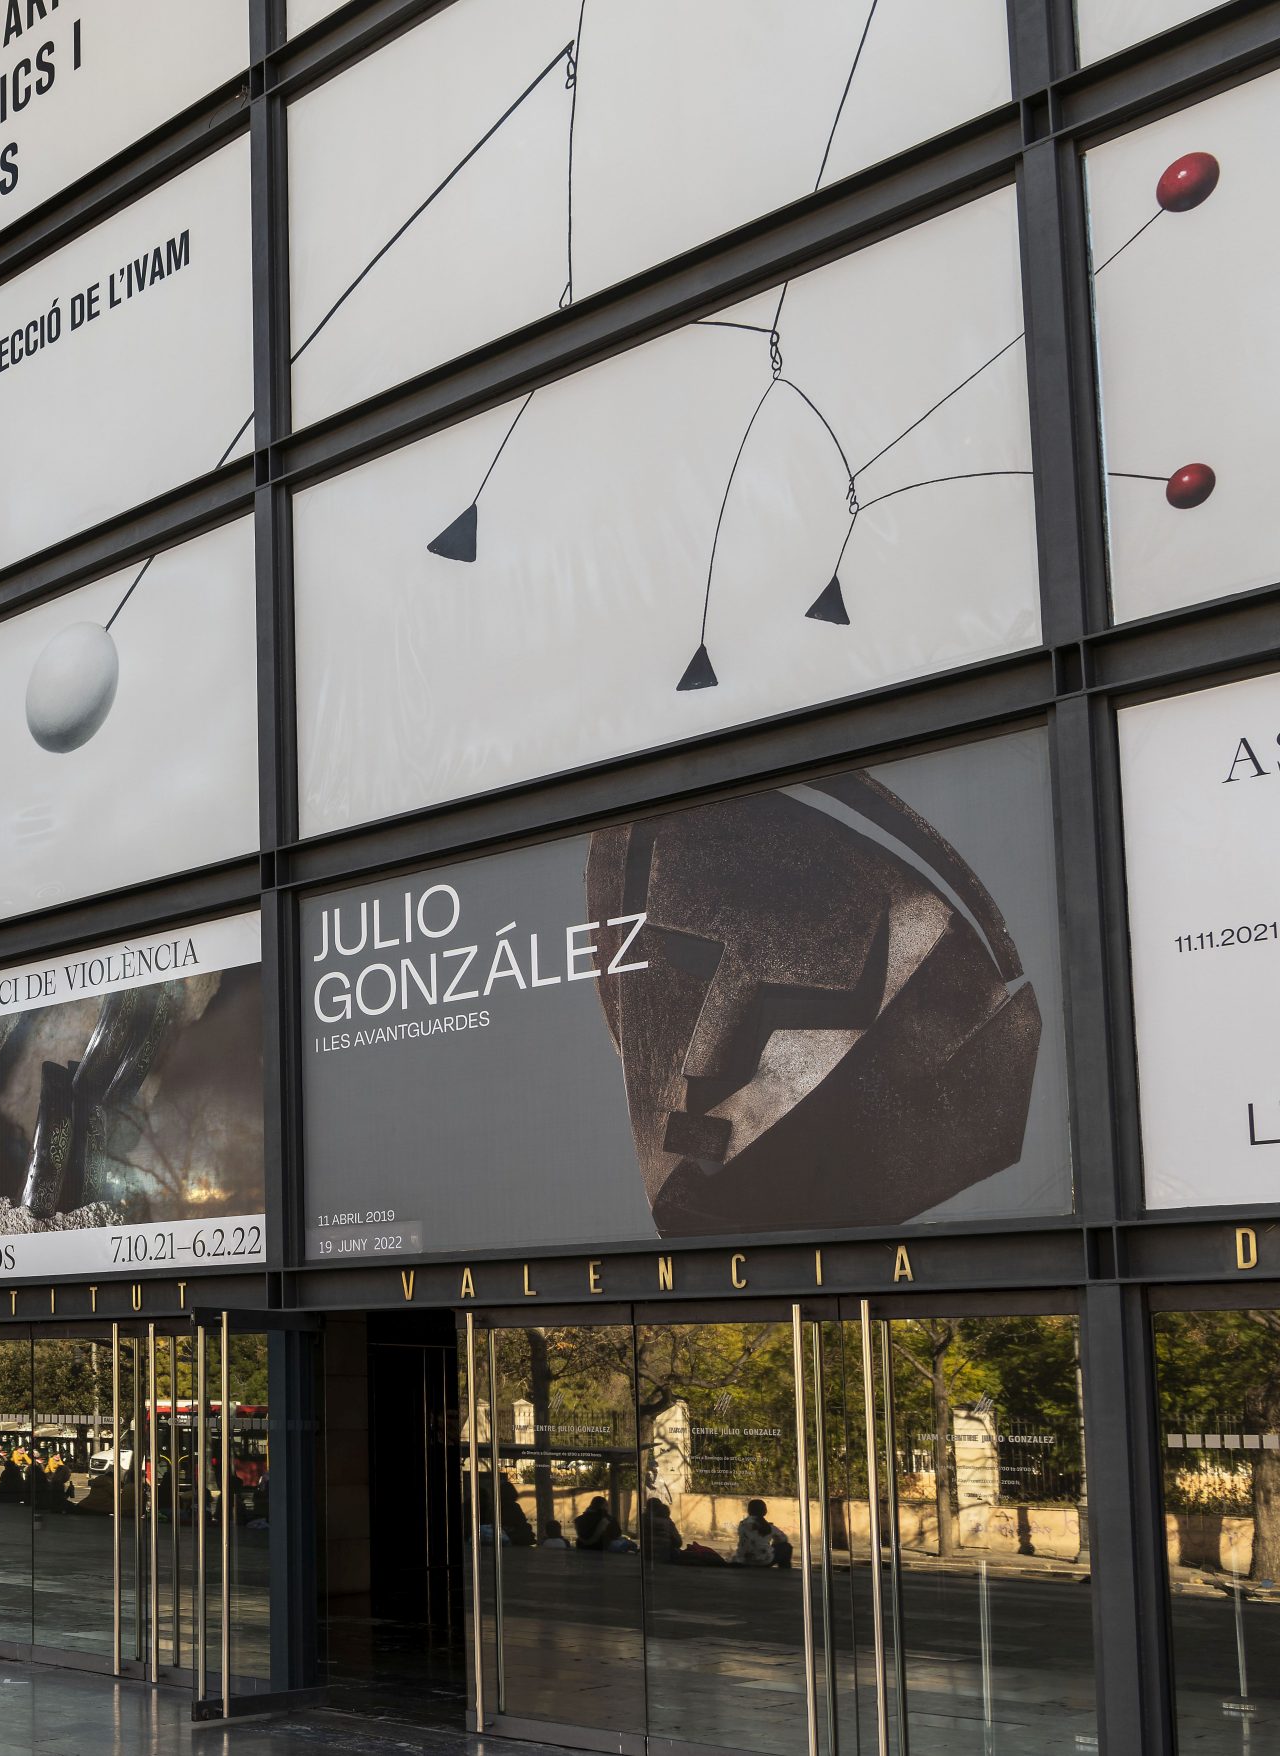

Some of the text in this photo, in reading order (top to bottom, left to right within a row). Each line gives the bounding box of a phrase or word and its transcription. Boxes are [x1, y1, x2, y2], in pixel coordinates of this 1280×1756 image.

[73, 18, 81, 71] I
[70, 282, 101, 331] DE
[109, 228, 191, 309] L'IVAM
[1221, 733, 1280, 784] A
[313, 884, 461, 962] JULIO
[1174, 921, 1278, 953] 11.11.2021
[25, 969, 57, 1000] DE
[63, 938, 200, 991] VIOLÈNCIA
[313, 912, 650, 1024] GONZÁLEZ
[315, 1010, 491, 1053] I LES AVANTGUARDES
[318, 1209, 395, 1227] 11 ABRIL 2019
[319, 1235, 402, 1254] 19 JUNY 2022
[558, 1425, 575, 1433] JULIO
[577, 1425, 611, 1433] GONZALEZ
[691, 1427, 718, 1435] CENTRE
[721, 1428, 740, 1437] JULIO
[743, 1428, 781, 1436] GONZALEZ
[917, 1433, 939, 1441] IVAM
[1008, 1435, 1055, 1444] GONZALEZ
